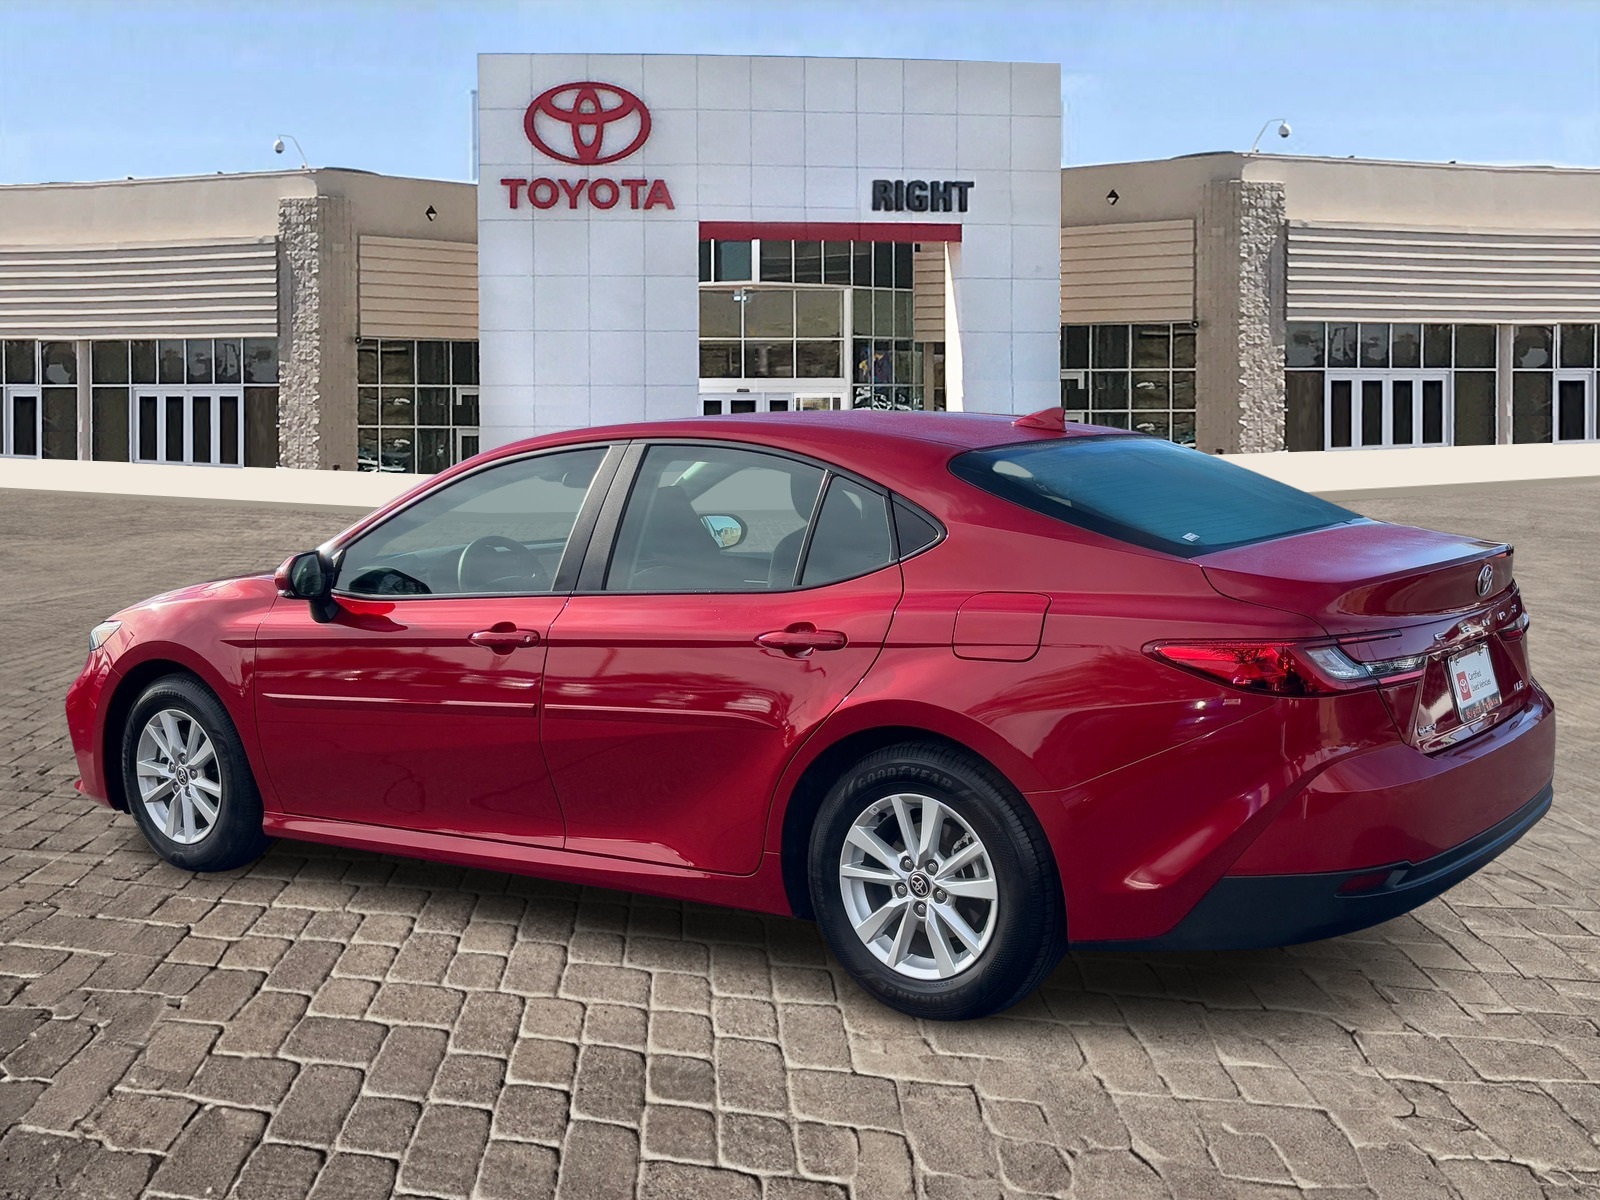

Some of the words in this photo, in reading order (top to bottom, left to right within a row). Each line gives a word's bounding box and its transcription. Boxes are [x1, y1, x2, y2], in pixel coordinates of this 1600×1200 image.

[500, 177, 675, 210] TOYOTA
[872, 179, 975, 212] RIGHT
[1468, 668, 1482, 681] Certified
[856, 765, 953, 788] GOODYEAR
